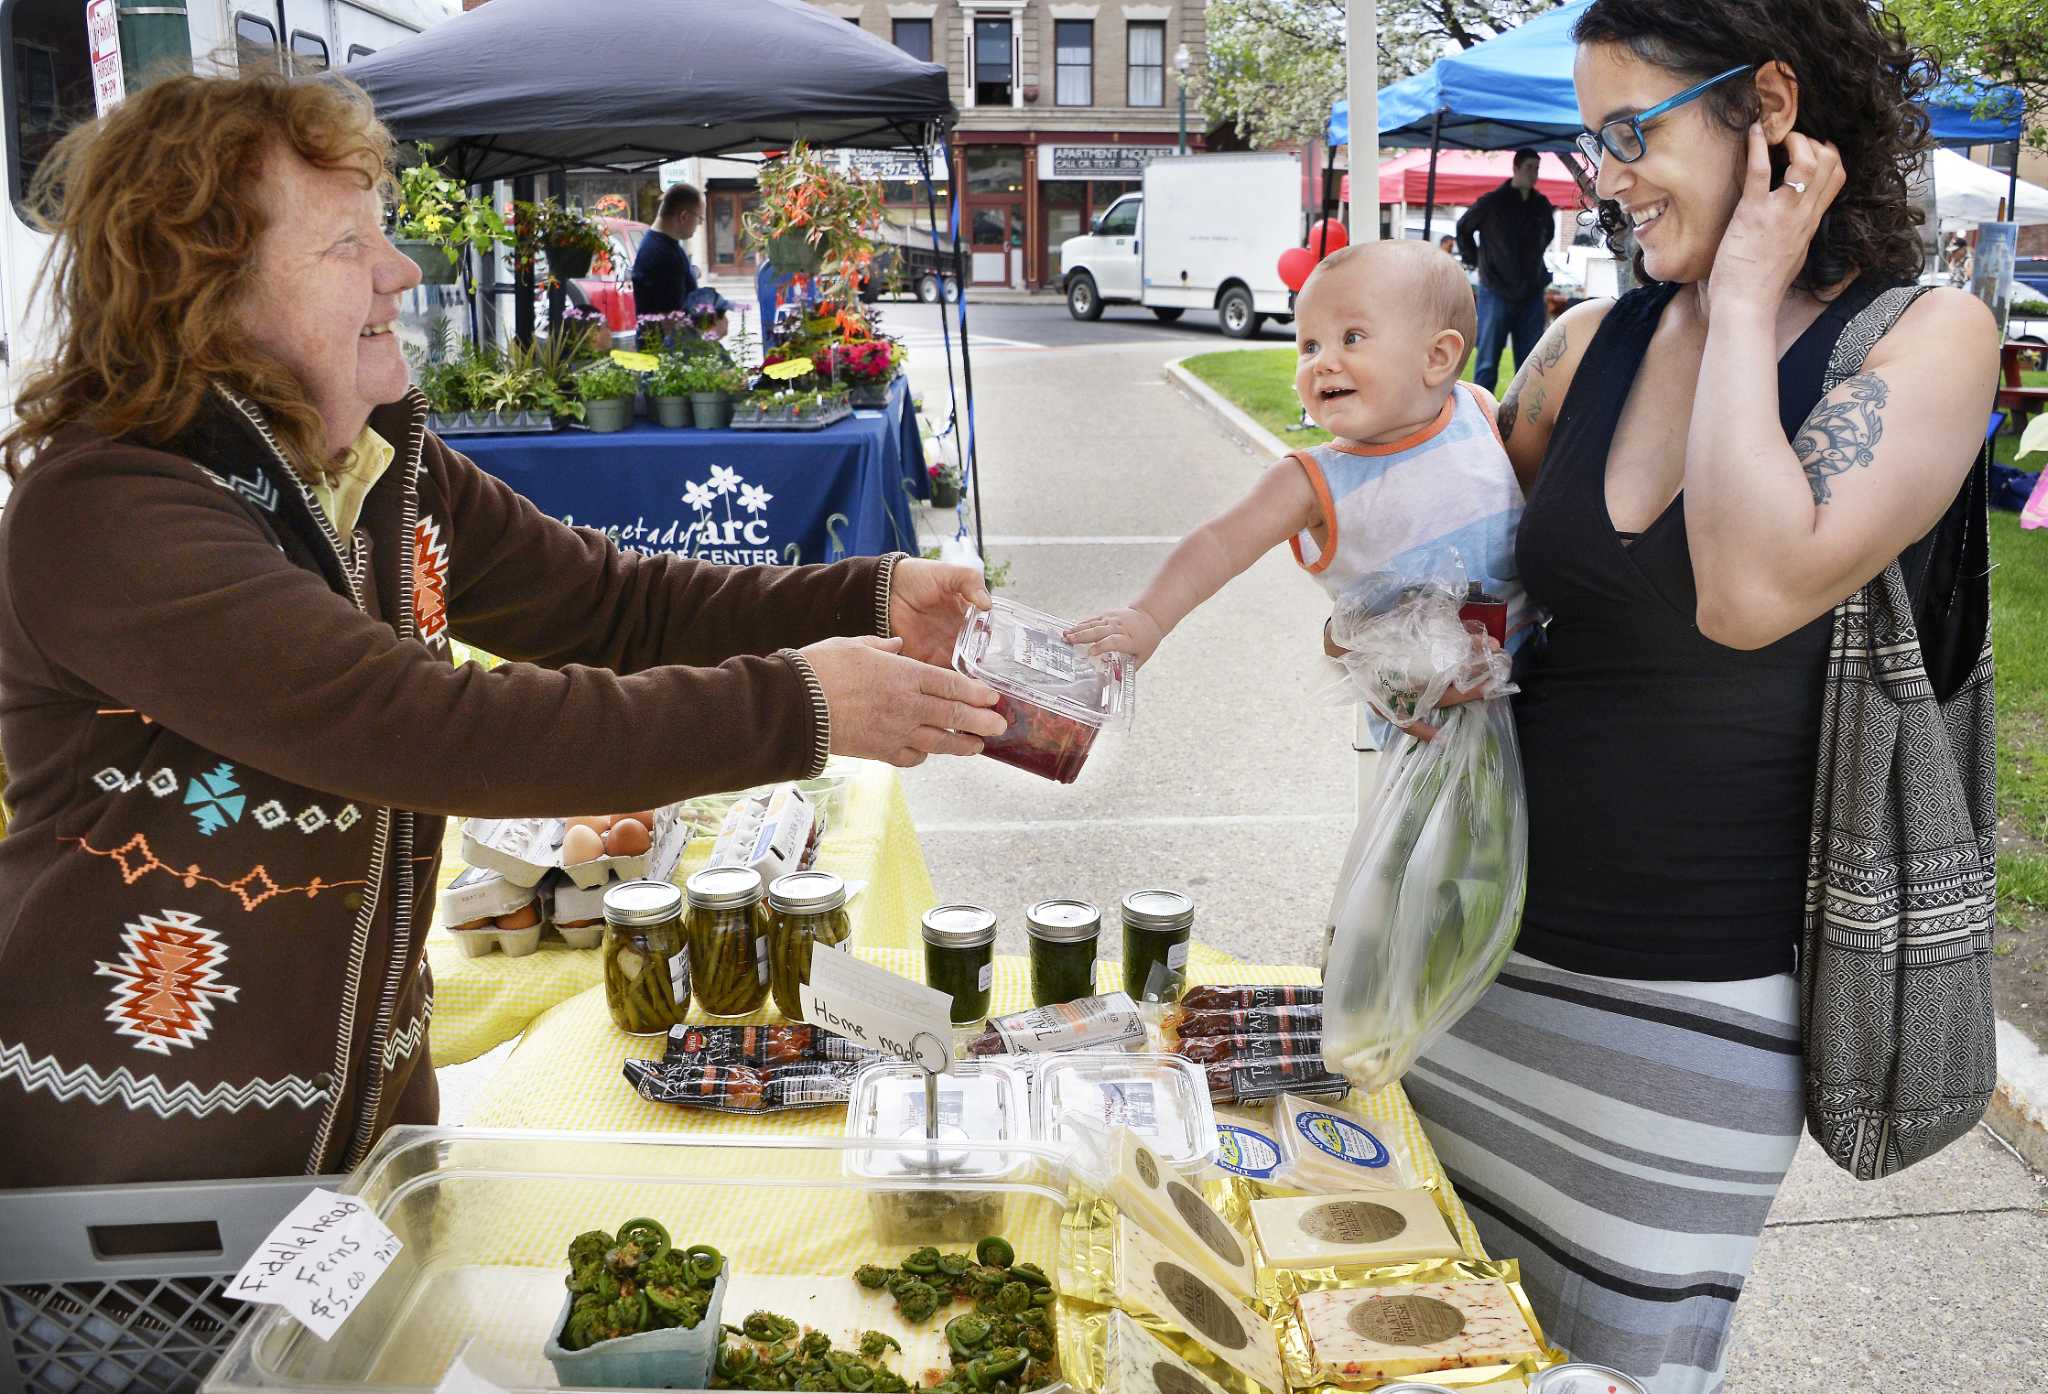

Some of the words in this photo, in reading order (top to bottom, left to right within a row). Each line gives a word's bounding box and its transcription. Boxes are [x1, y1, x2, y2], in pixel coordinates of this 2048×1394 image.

[697, 548, 779, 565] CENTER
[813, 997, 868, 1041] Home
[877, 1034, 924, 1063] made
[295, 1234, 360, 1287] Ferns
